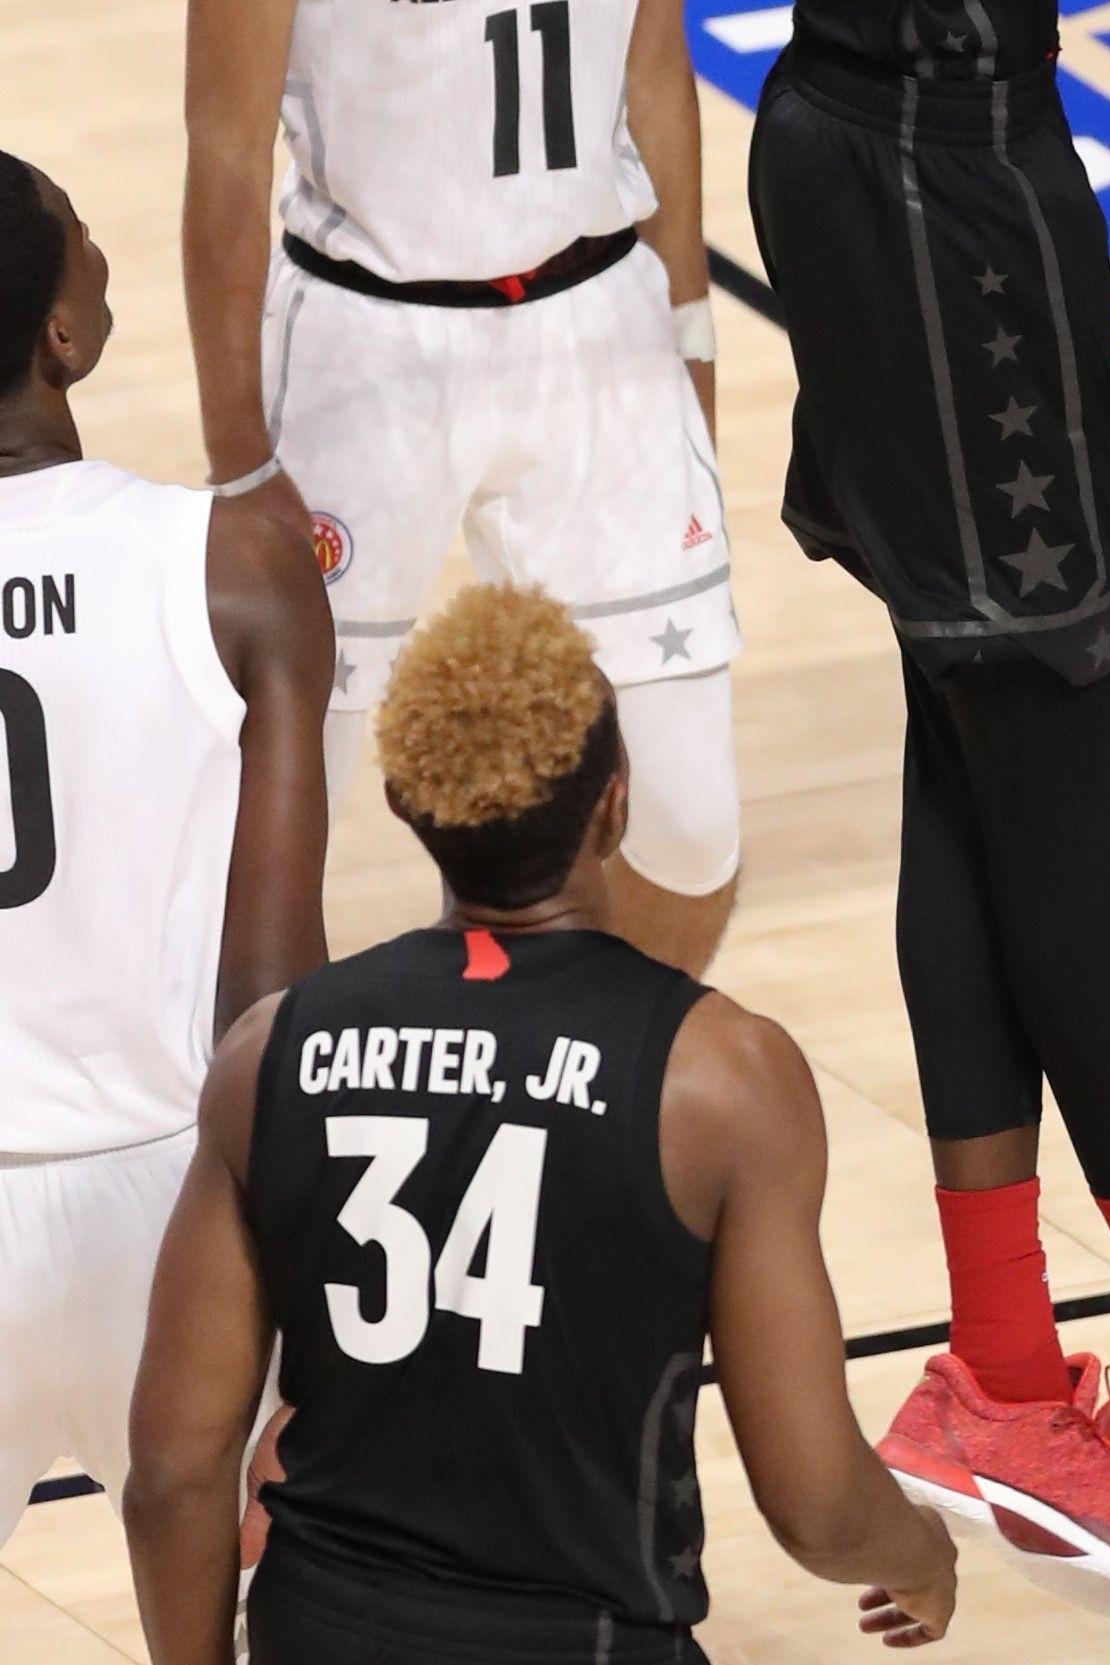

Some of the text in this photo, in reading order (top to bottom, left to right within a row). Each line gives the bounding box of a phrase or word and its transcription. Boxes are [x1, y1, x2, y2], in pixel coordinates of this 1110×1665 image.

[484, 0, 577, 177] 11
[300, 1026, 608, 1116] CARTER, JR.
[324, 1115, 548, 1374] 34
